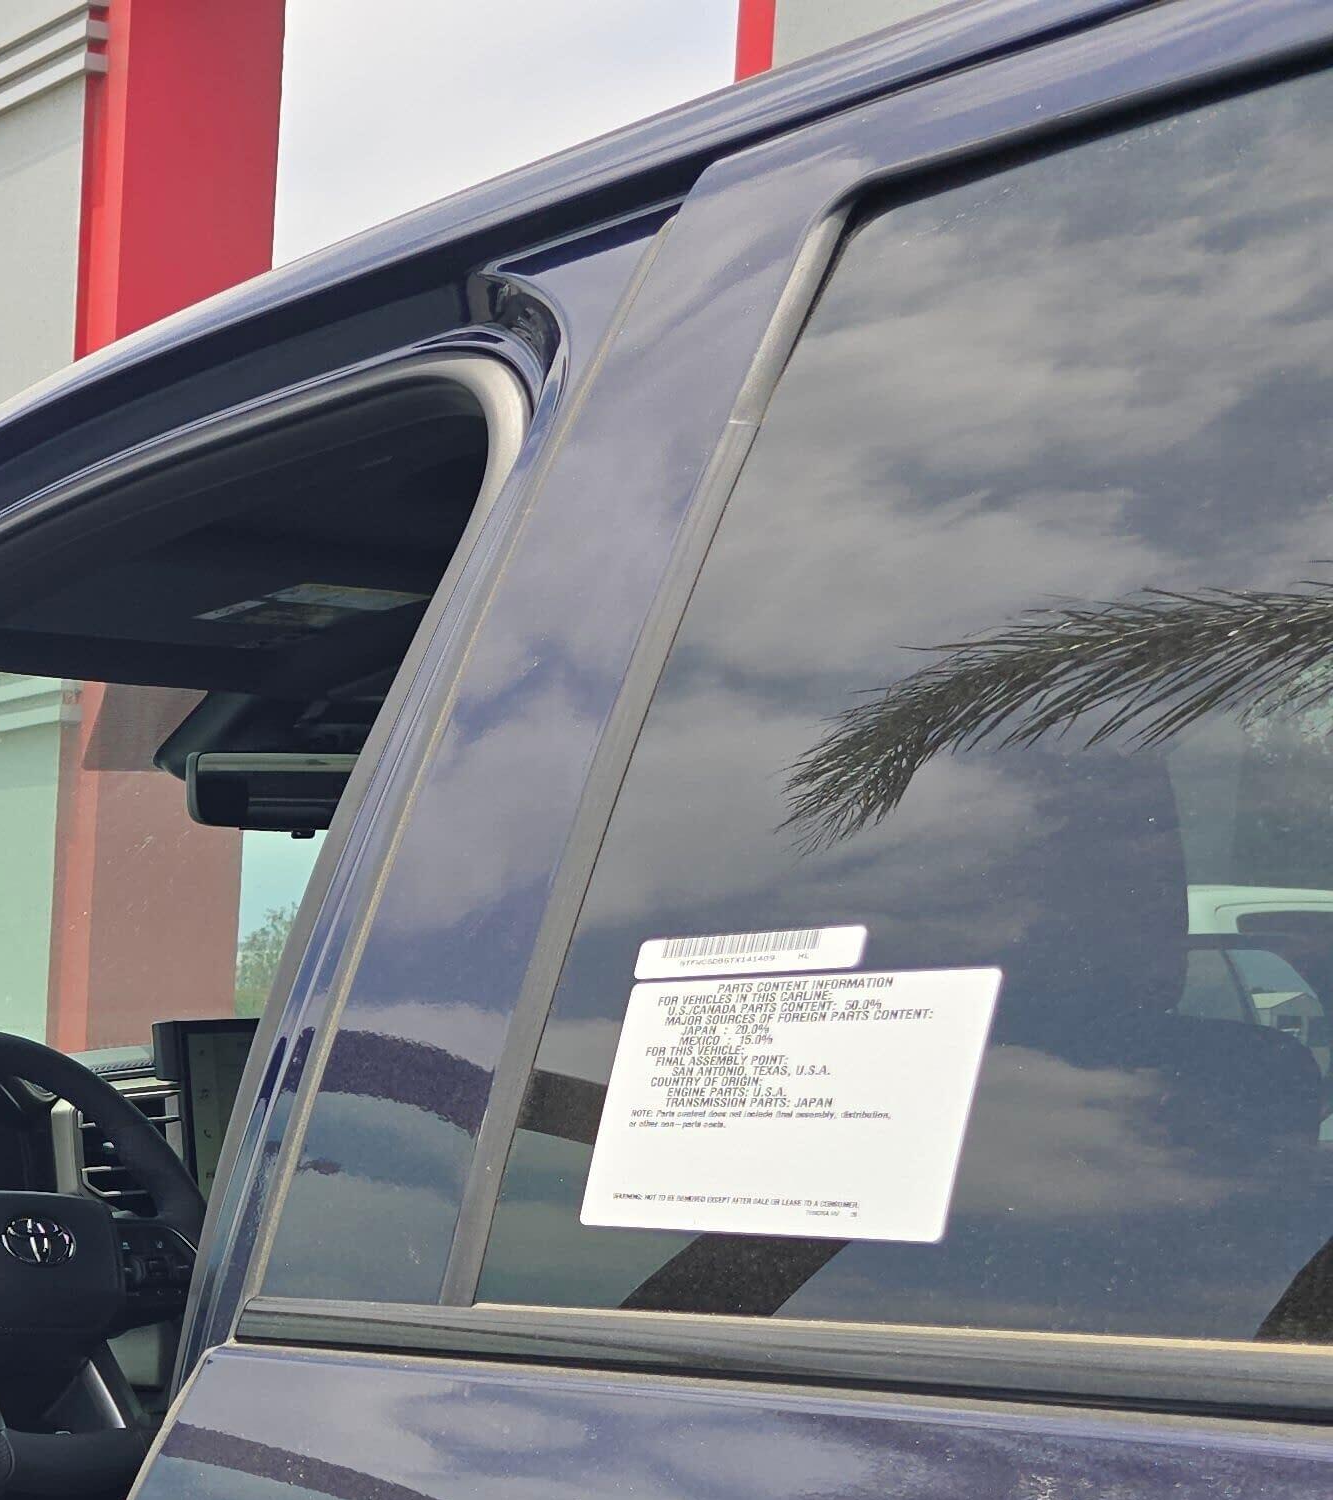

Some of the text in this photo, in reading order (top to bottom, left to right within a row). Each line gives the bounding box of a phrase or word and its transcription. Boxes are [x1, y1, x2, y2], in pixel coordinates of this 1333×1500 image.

[718, 977, 894, 994] PARTS CONTENT INFORMATION
[658, 991, 832, 1007] FOR VEHICLES IN THIS CARLINE:
[668, 1000, 882, 1016] U.S./CANADA PARTS CONTENT: 50.0%
[665, 1009, 933, 1026] MAJOR SOURCES OF FOREIGN PARTS CONTENT:
[681, 1026, 716, 1035] JAPAN
[735, 1025, 769, 1035] 20.0%
[679, 1036, 720, 1046] MEXICO
[740, 1035, 773, 1045] 15.0%
[646, 1045, 744, 1056] FOR THIS VEHICLE:
[655, 1055, 789, 1066] FINAL ASSEMBLY POINT:
[672, 1065, 831, 1077] SAN ANTONIO, TEXAS, U.S.A.
[651, 1076, 763, 1087] COUNTRY OF ORIGIN:
[667, 1087, 787, 1097] ENGINE PARTS: U.S.A.
[665, 1098, 833, 1108] TRANSMISSION PARTS: JAPAN
